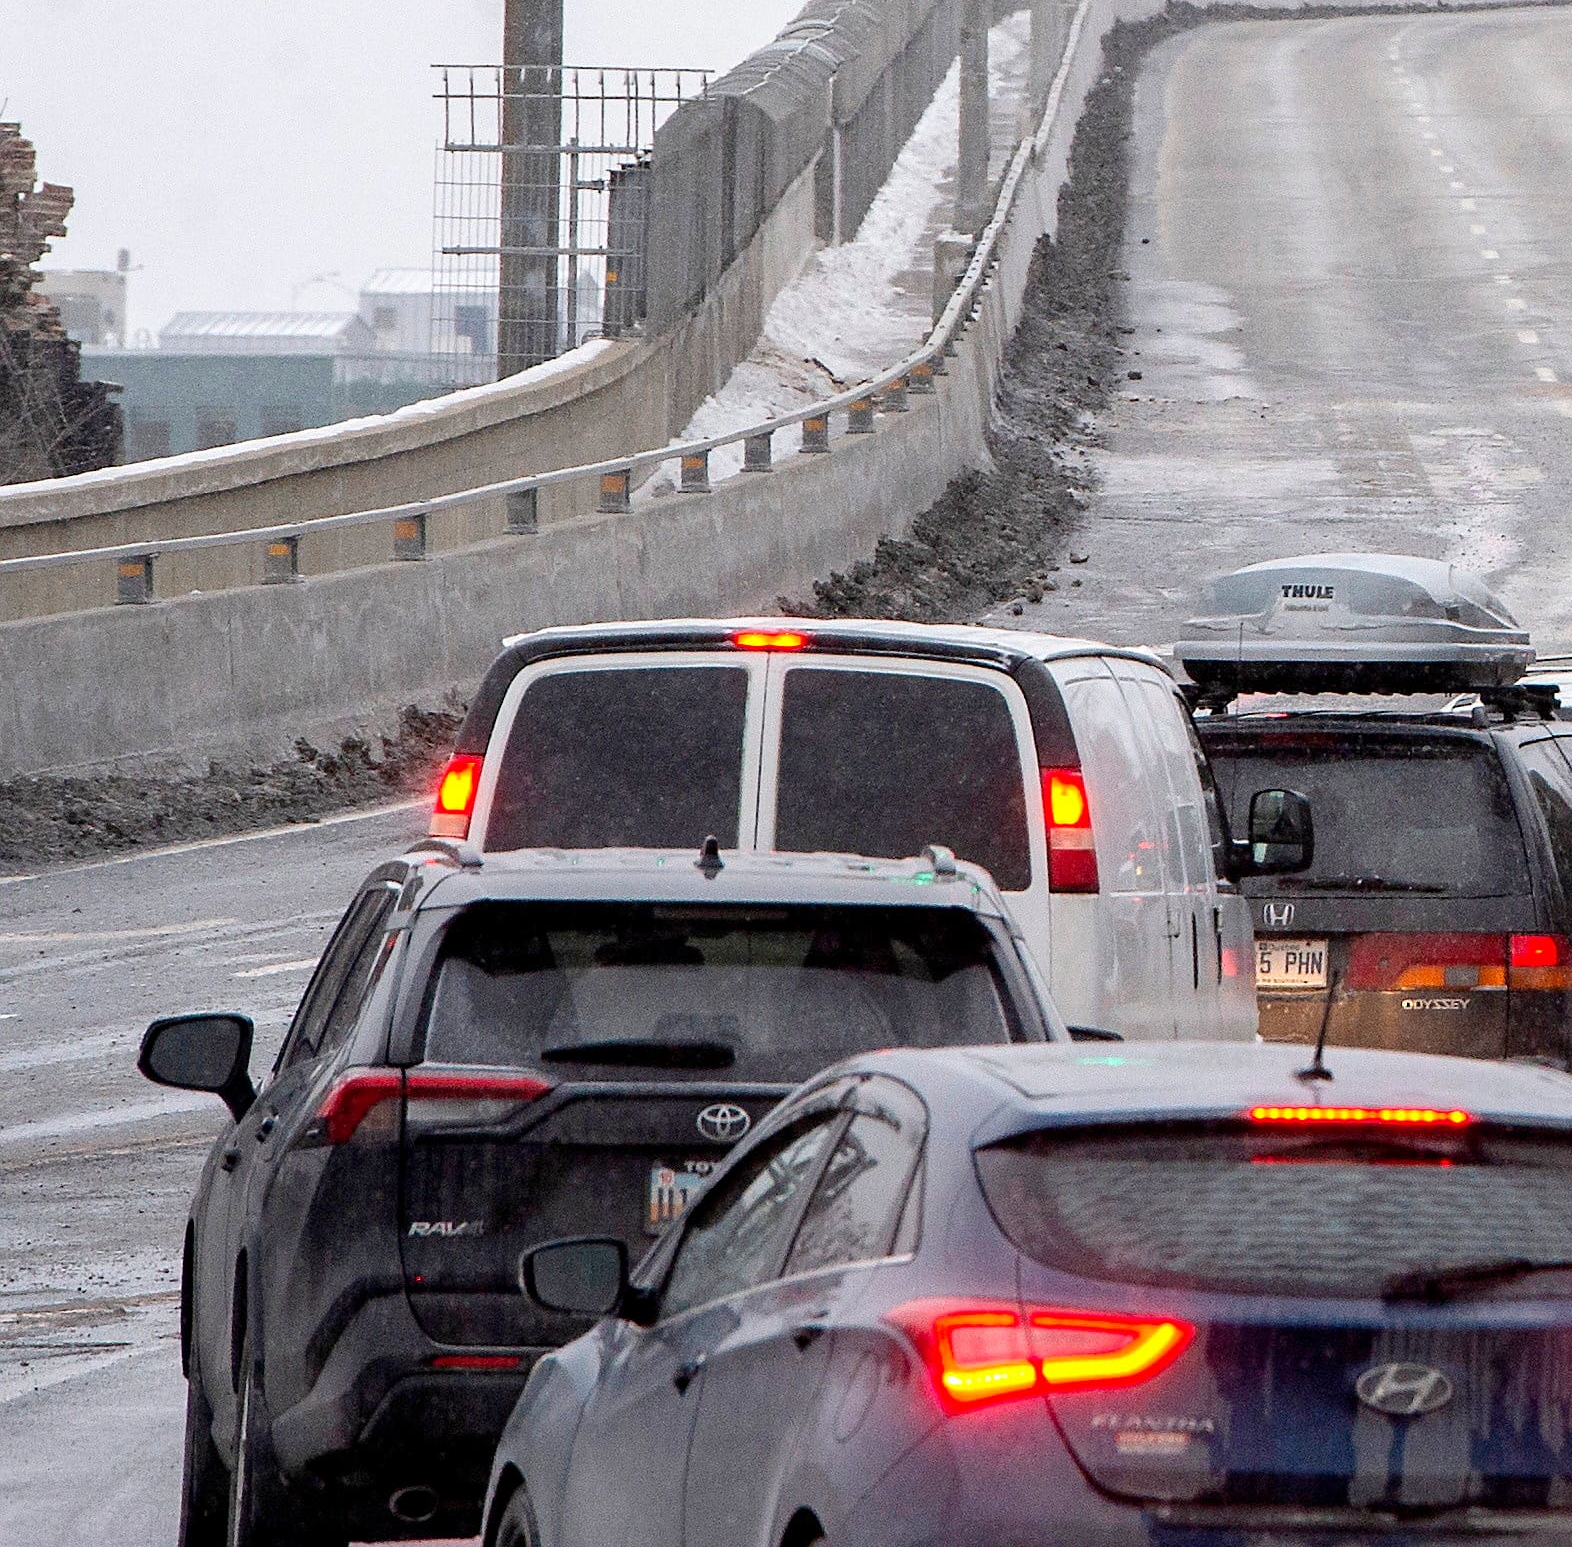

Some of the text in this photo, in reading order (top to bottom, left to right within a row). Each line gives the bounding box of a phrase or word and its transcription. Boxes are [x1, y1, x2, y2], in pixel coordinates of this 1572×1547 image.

[1281, 584, 1334, 599] THULE
[1284, 951, 1323, 975] PHN
[1402, 998, 1470, 1011] ODYSSEY
